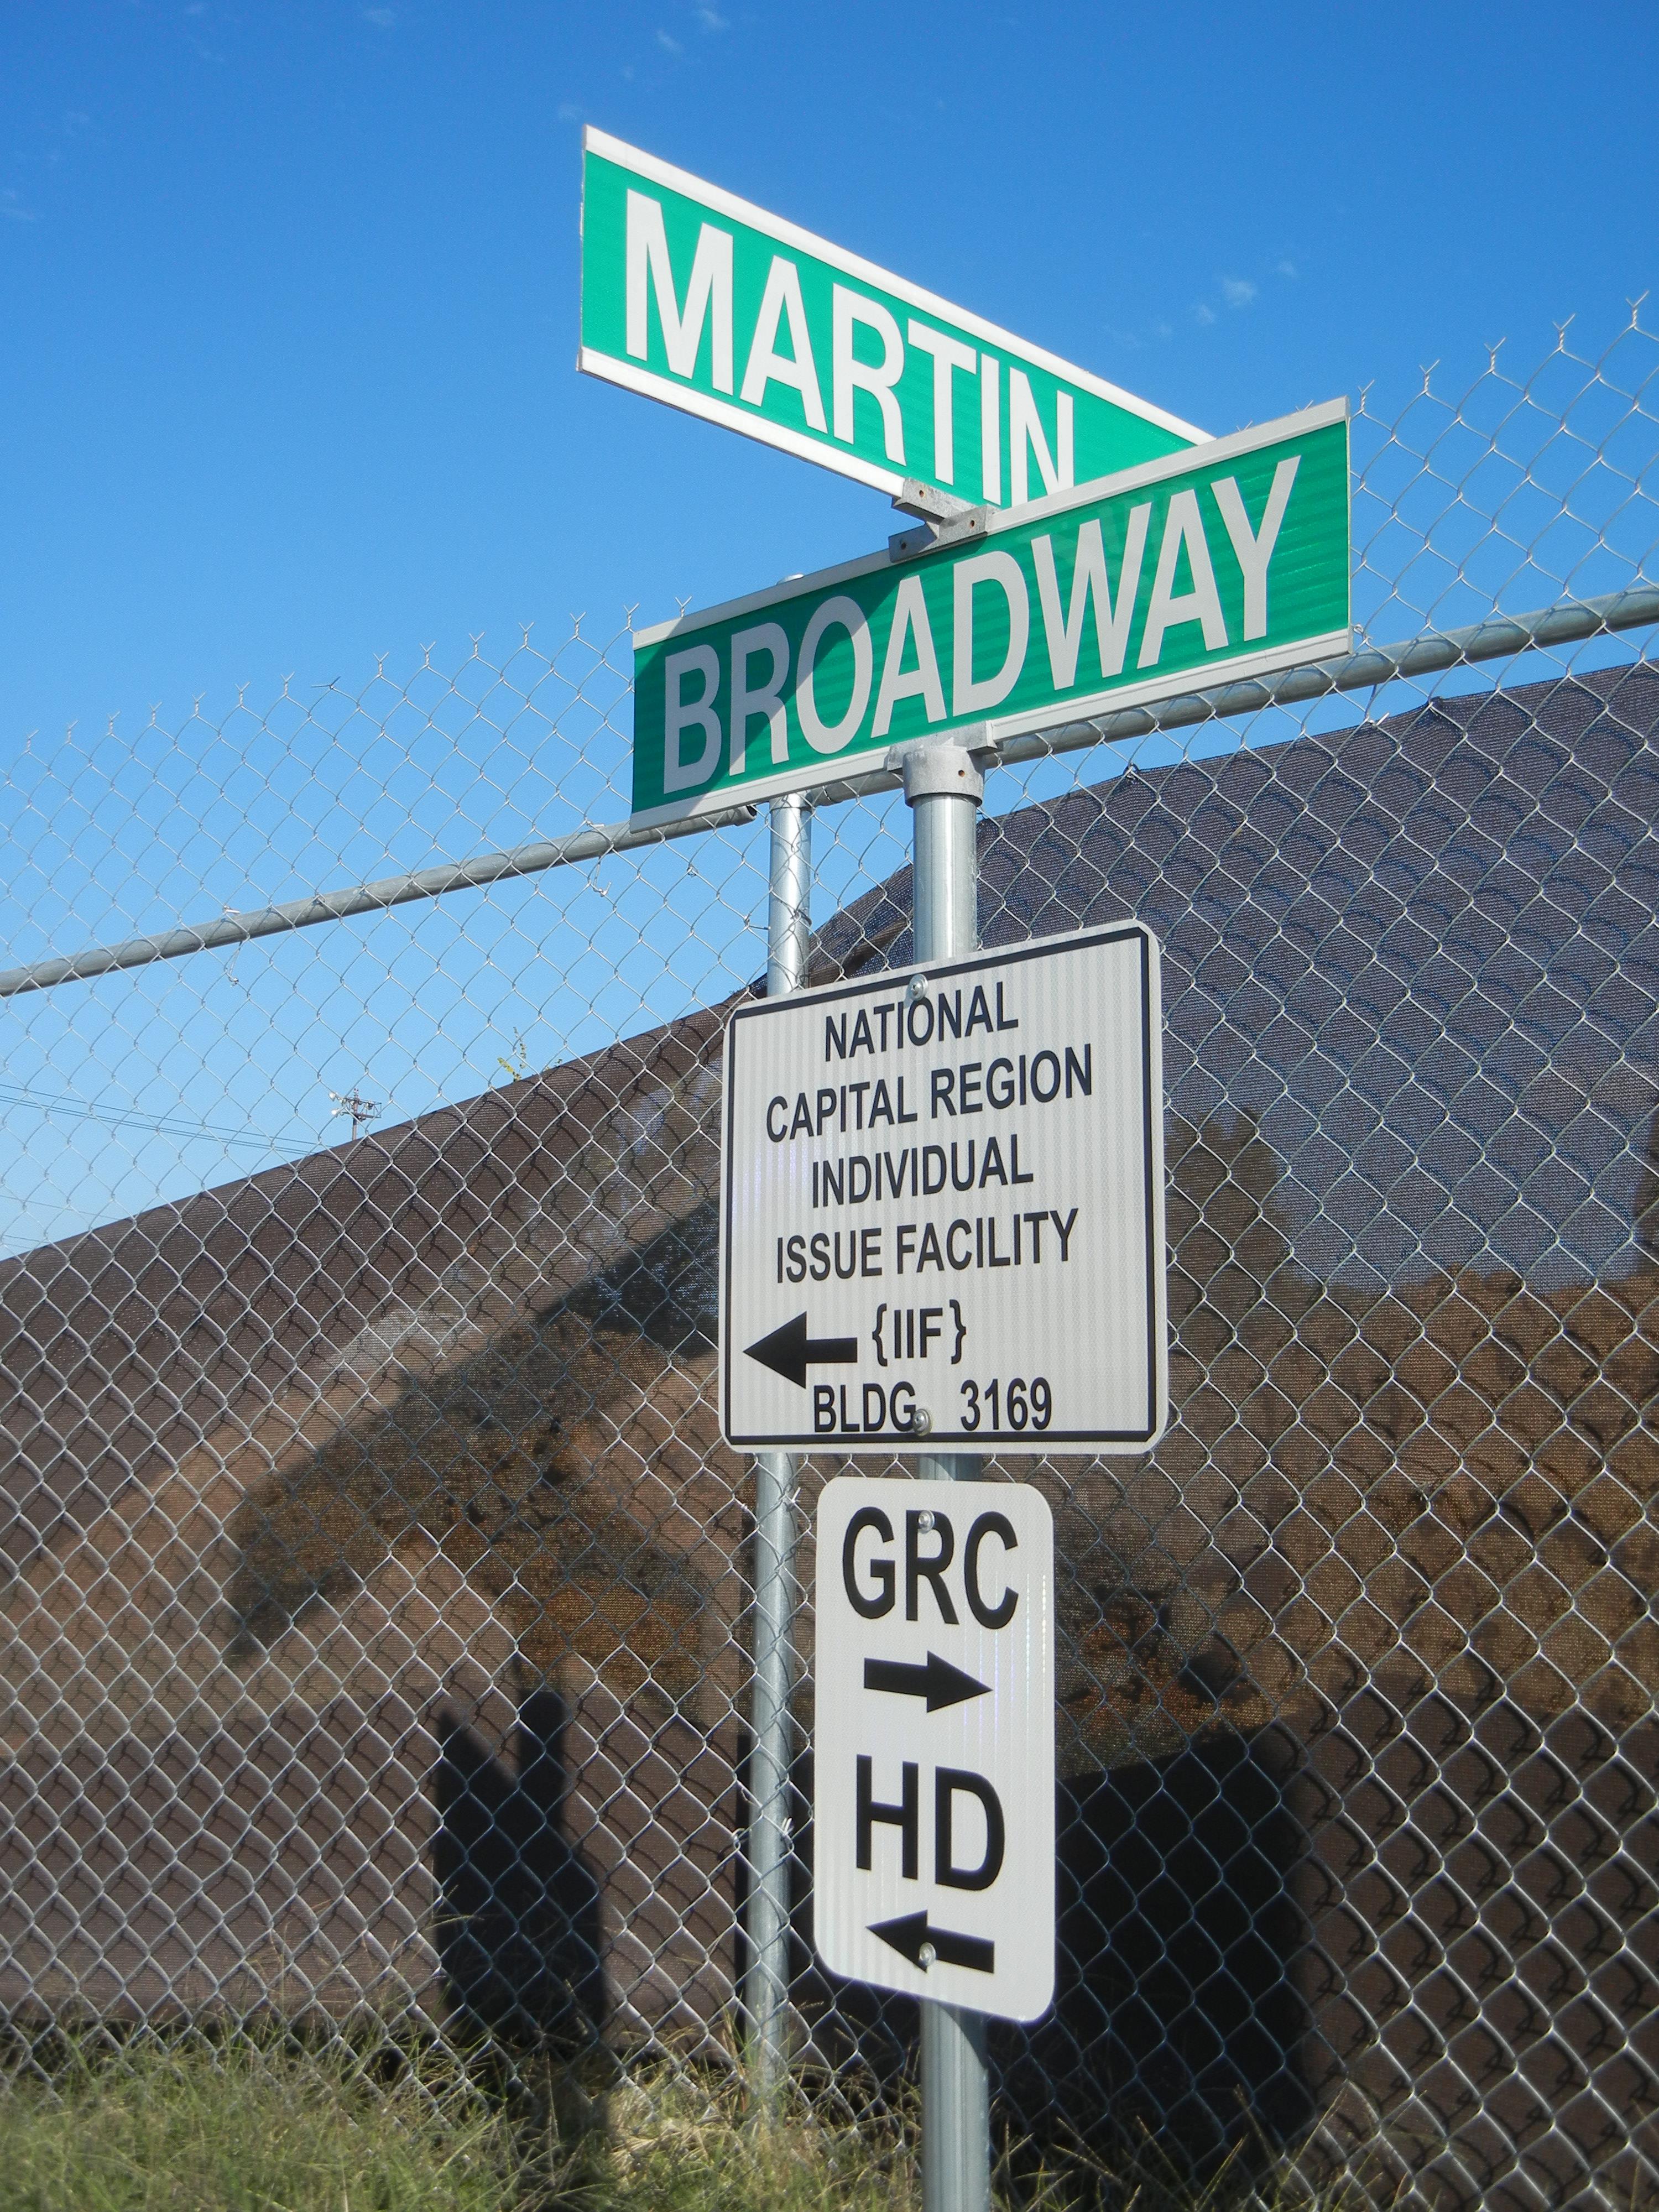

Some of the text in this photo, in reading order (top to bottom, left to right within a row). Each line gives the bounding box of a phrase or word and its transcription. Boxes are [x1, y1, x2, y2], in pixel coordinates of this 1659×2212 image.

[625, 189, 1074, 505] MARTIN
[664, 455, 1301, 794] BROADWAY
[825, 982, 1019, 1062] NATIONAL
[766, 1044, 1092, 1142] CAPITAL REGION
[812, 1134, 1033, 1208] INDIVIDUAL
[777, 1208, 1078, 1283] ISSUE FACILITY
[872, 1300, 967, 1367] {IIF}
[960, 1377, 1052, 1431] 3169
[842, 1506, 1019, 1630] GRC
[855, 1754, 1005, 1891] HD
